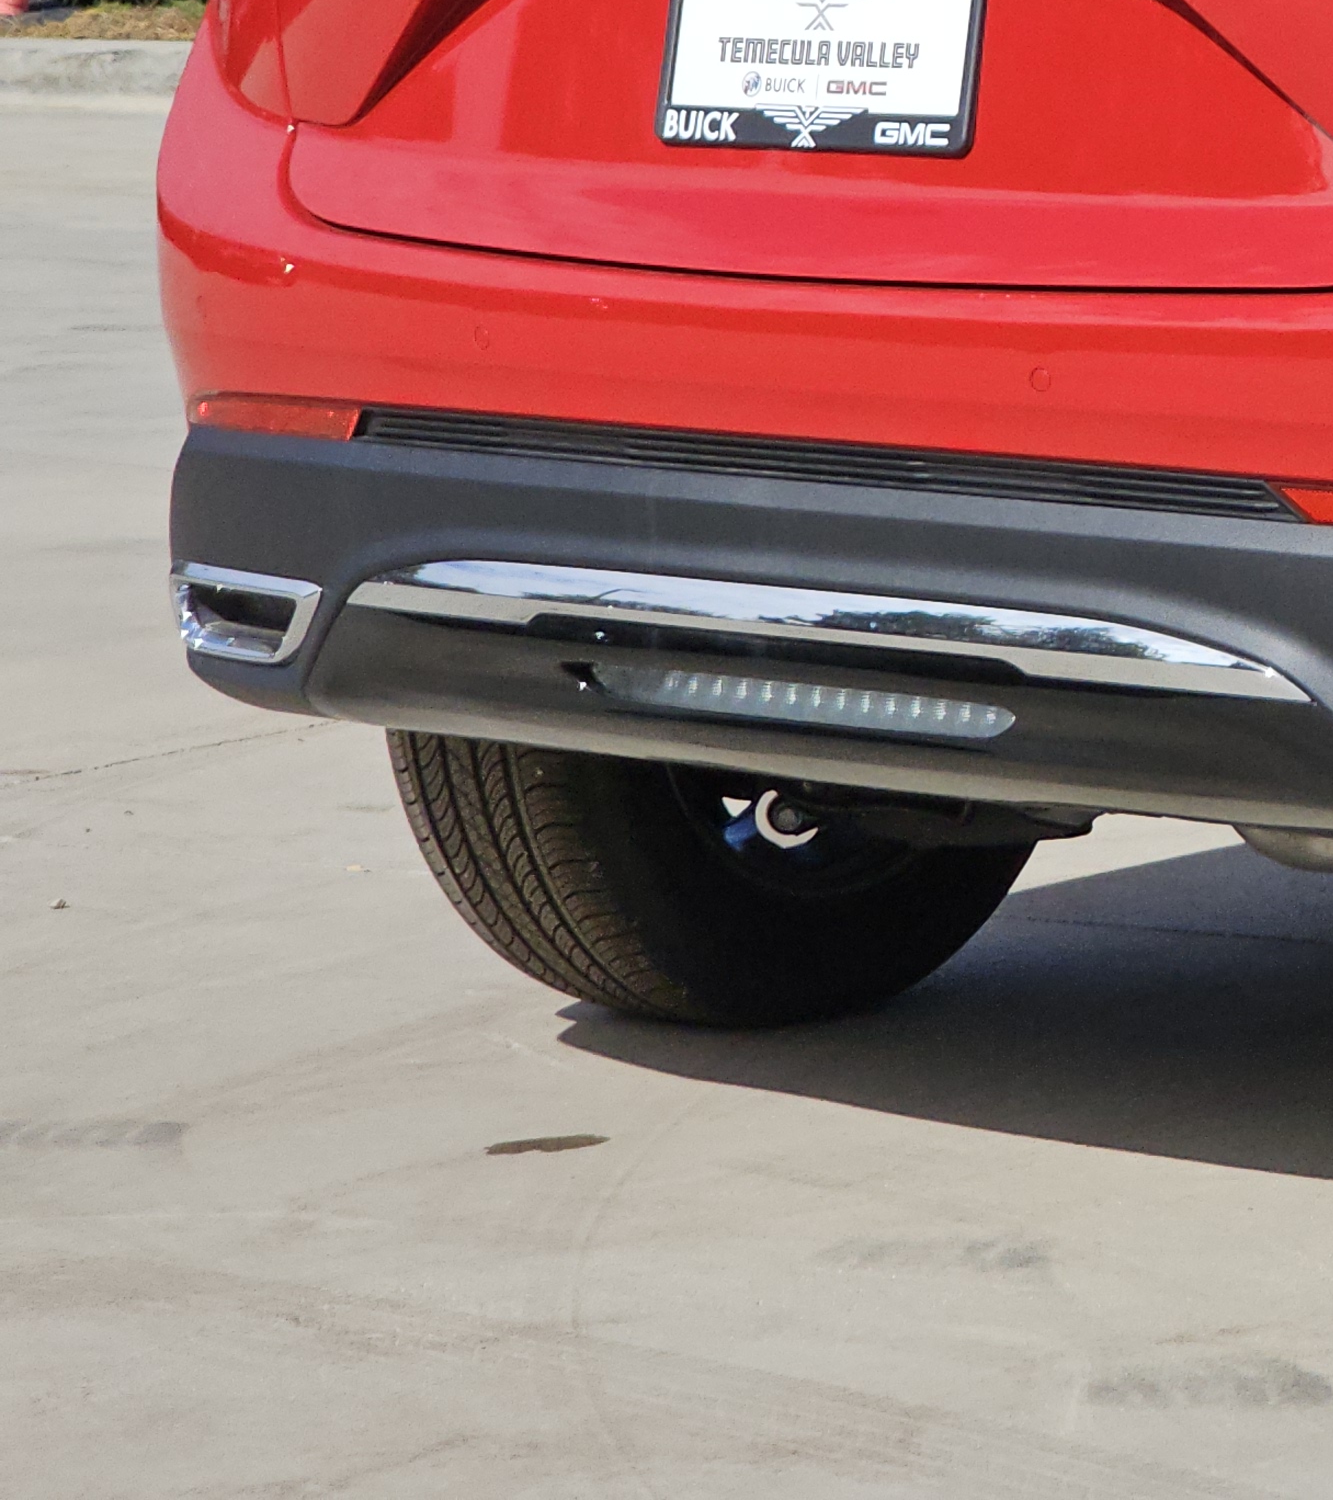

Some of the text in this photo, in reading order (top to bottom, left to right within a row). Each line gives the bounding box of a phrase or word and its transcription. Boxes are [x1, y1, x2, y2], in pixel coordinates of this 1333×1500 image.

[719, 37, 920, 69] TEMECULA VALLEY
[765, 77, 888, 96] BUICK GMC
[662, 109, 951, 147] BUICK GMC
